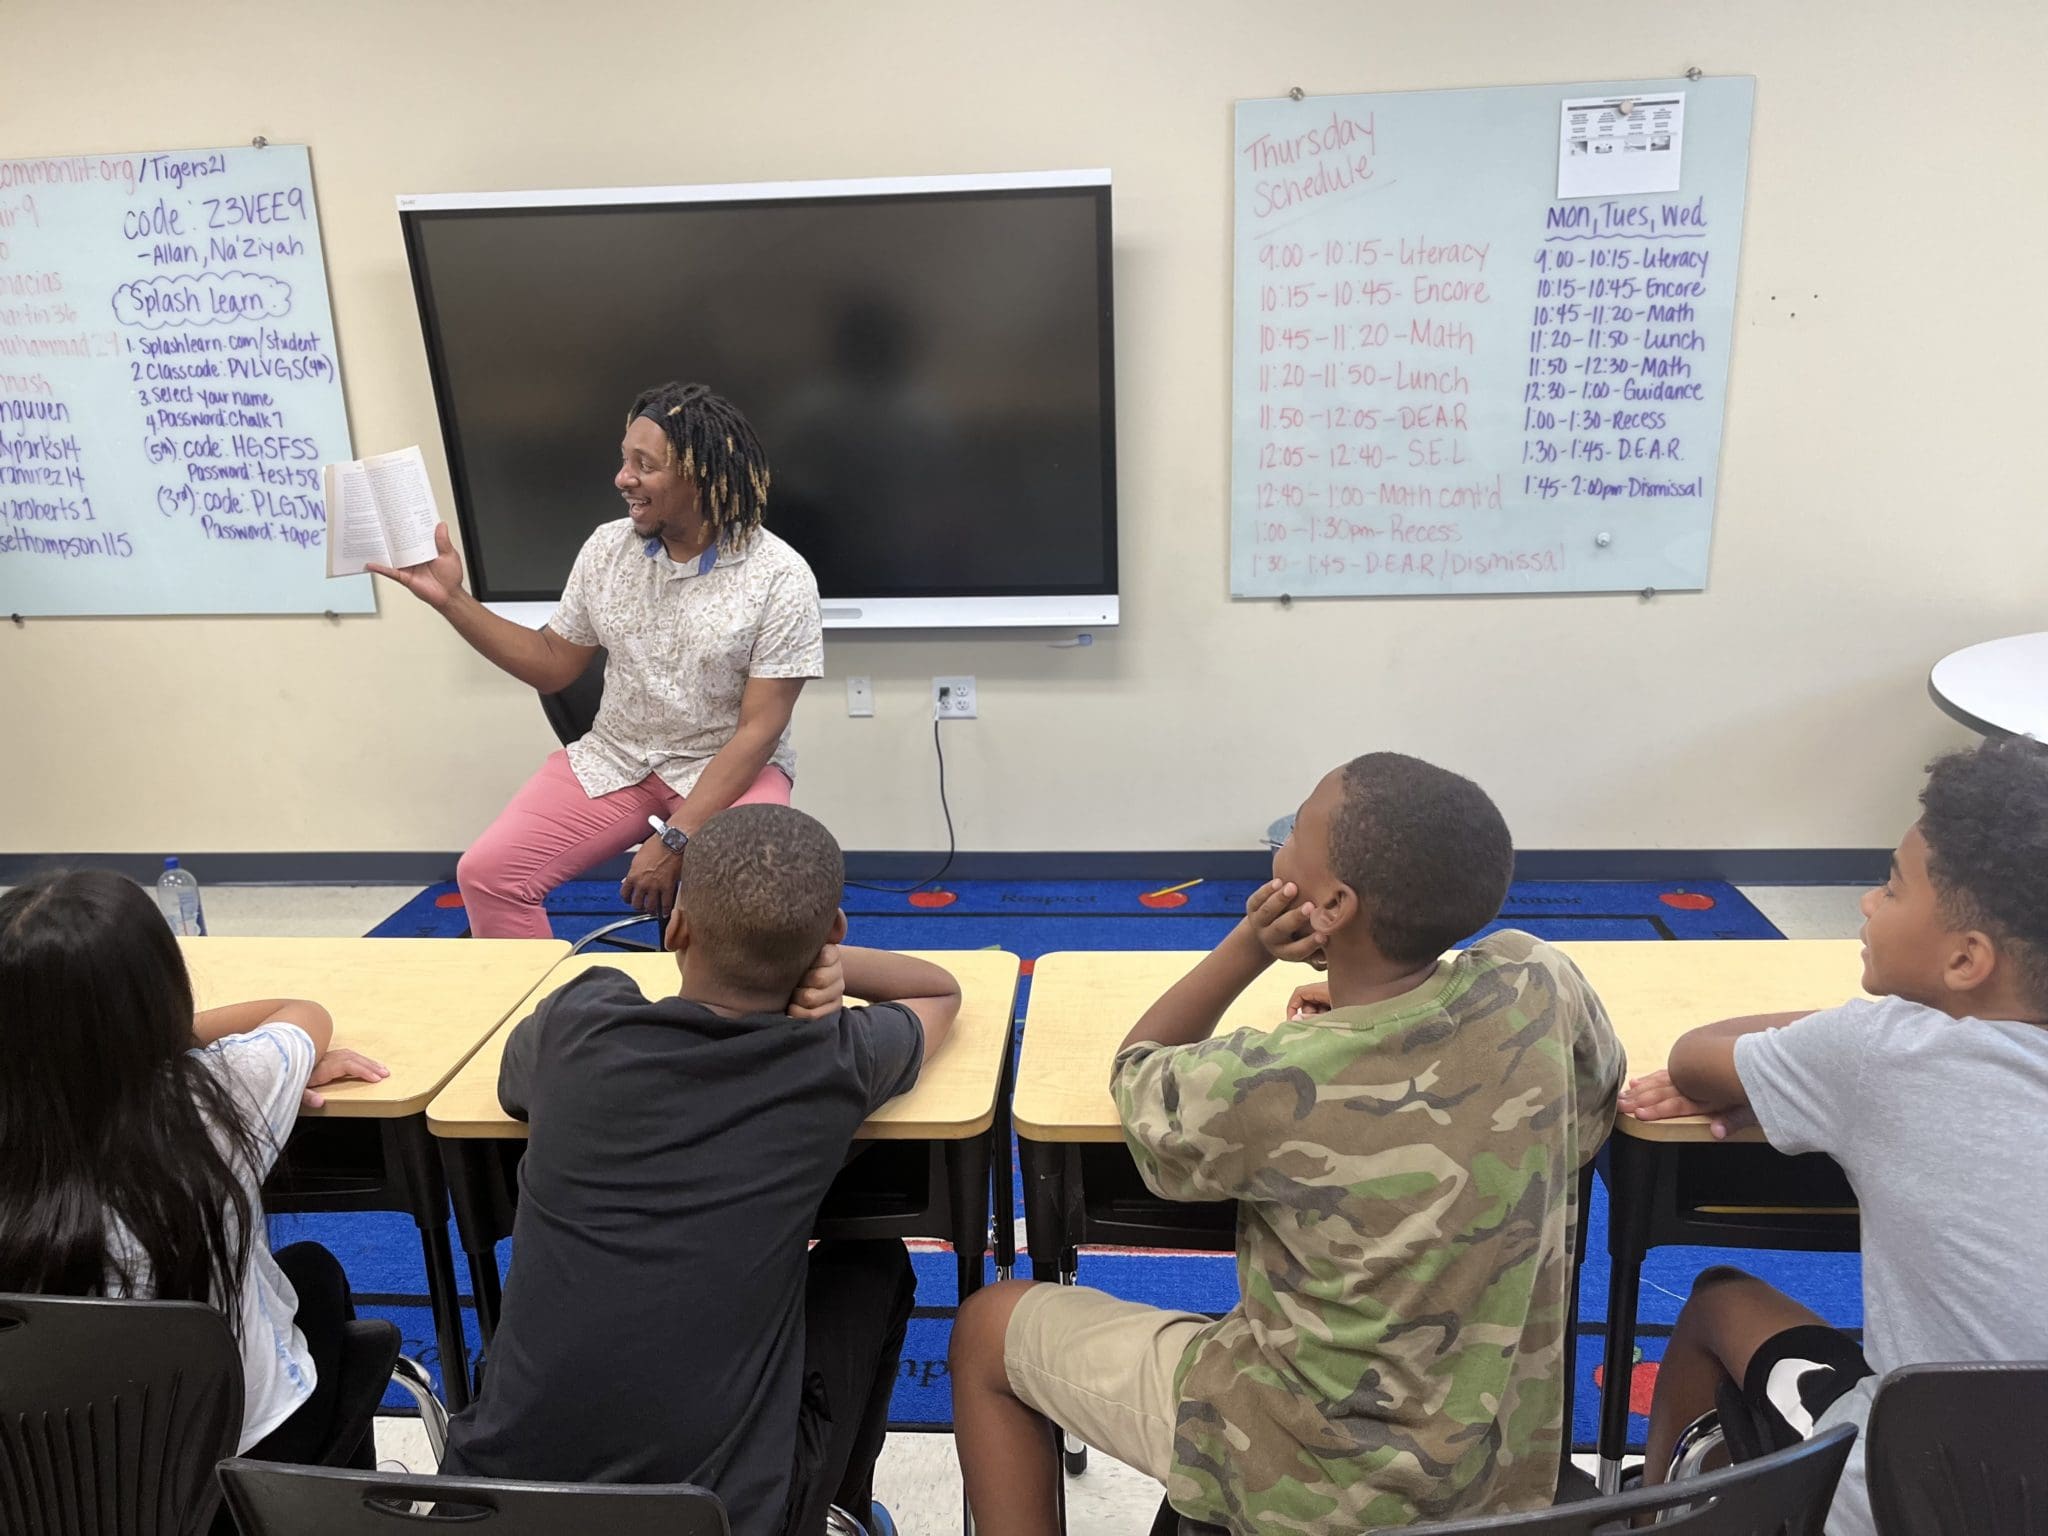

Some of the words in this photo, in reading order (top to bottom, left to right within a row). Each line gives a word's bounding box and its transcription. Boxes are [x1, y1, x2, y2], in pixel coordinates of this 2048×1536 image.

[1243, 111, 1376, 172] Thursday
[1253, 155, 1374, 219] Schedule
[1661, 196, 1708, 228] Wed
[1414, 275, 1490, 304] Encore
[1646, 278, 1706, 298] Encore
[131, 287, 200, 317] Splash
[1647, 302, 1694, 322] Math
[1411, 318, 1473, 354] Math
[1643, 328, 1704, 352] Lunch
[1397, 360, 1468, 395] Lunch
[1640, 355, 1691, 378] Math
[231, 391, 274, 407] name
[1624, 377, 1704, 400] Guidance
[1613, 411, 1667, 430] Recess
[1379, 482, 1431, 507] Math
[279, 523, 326, 549] tape
[1391, 513, 1463, 543] Recess
